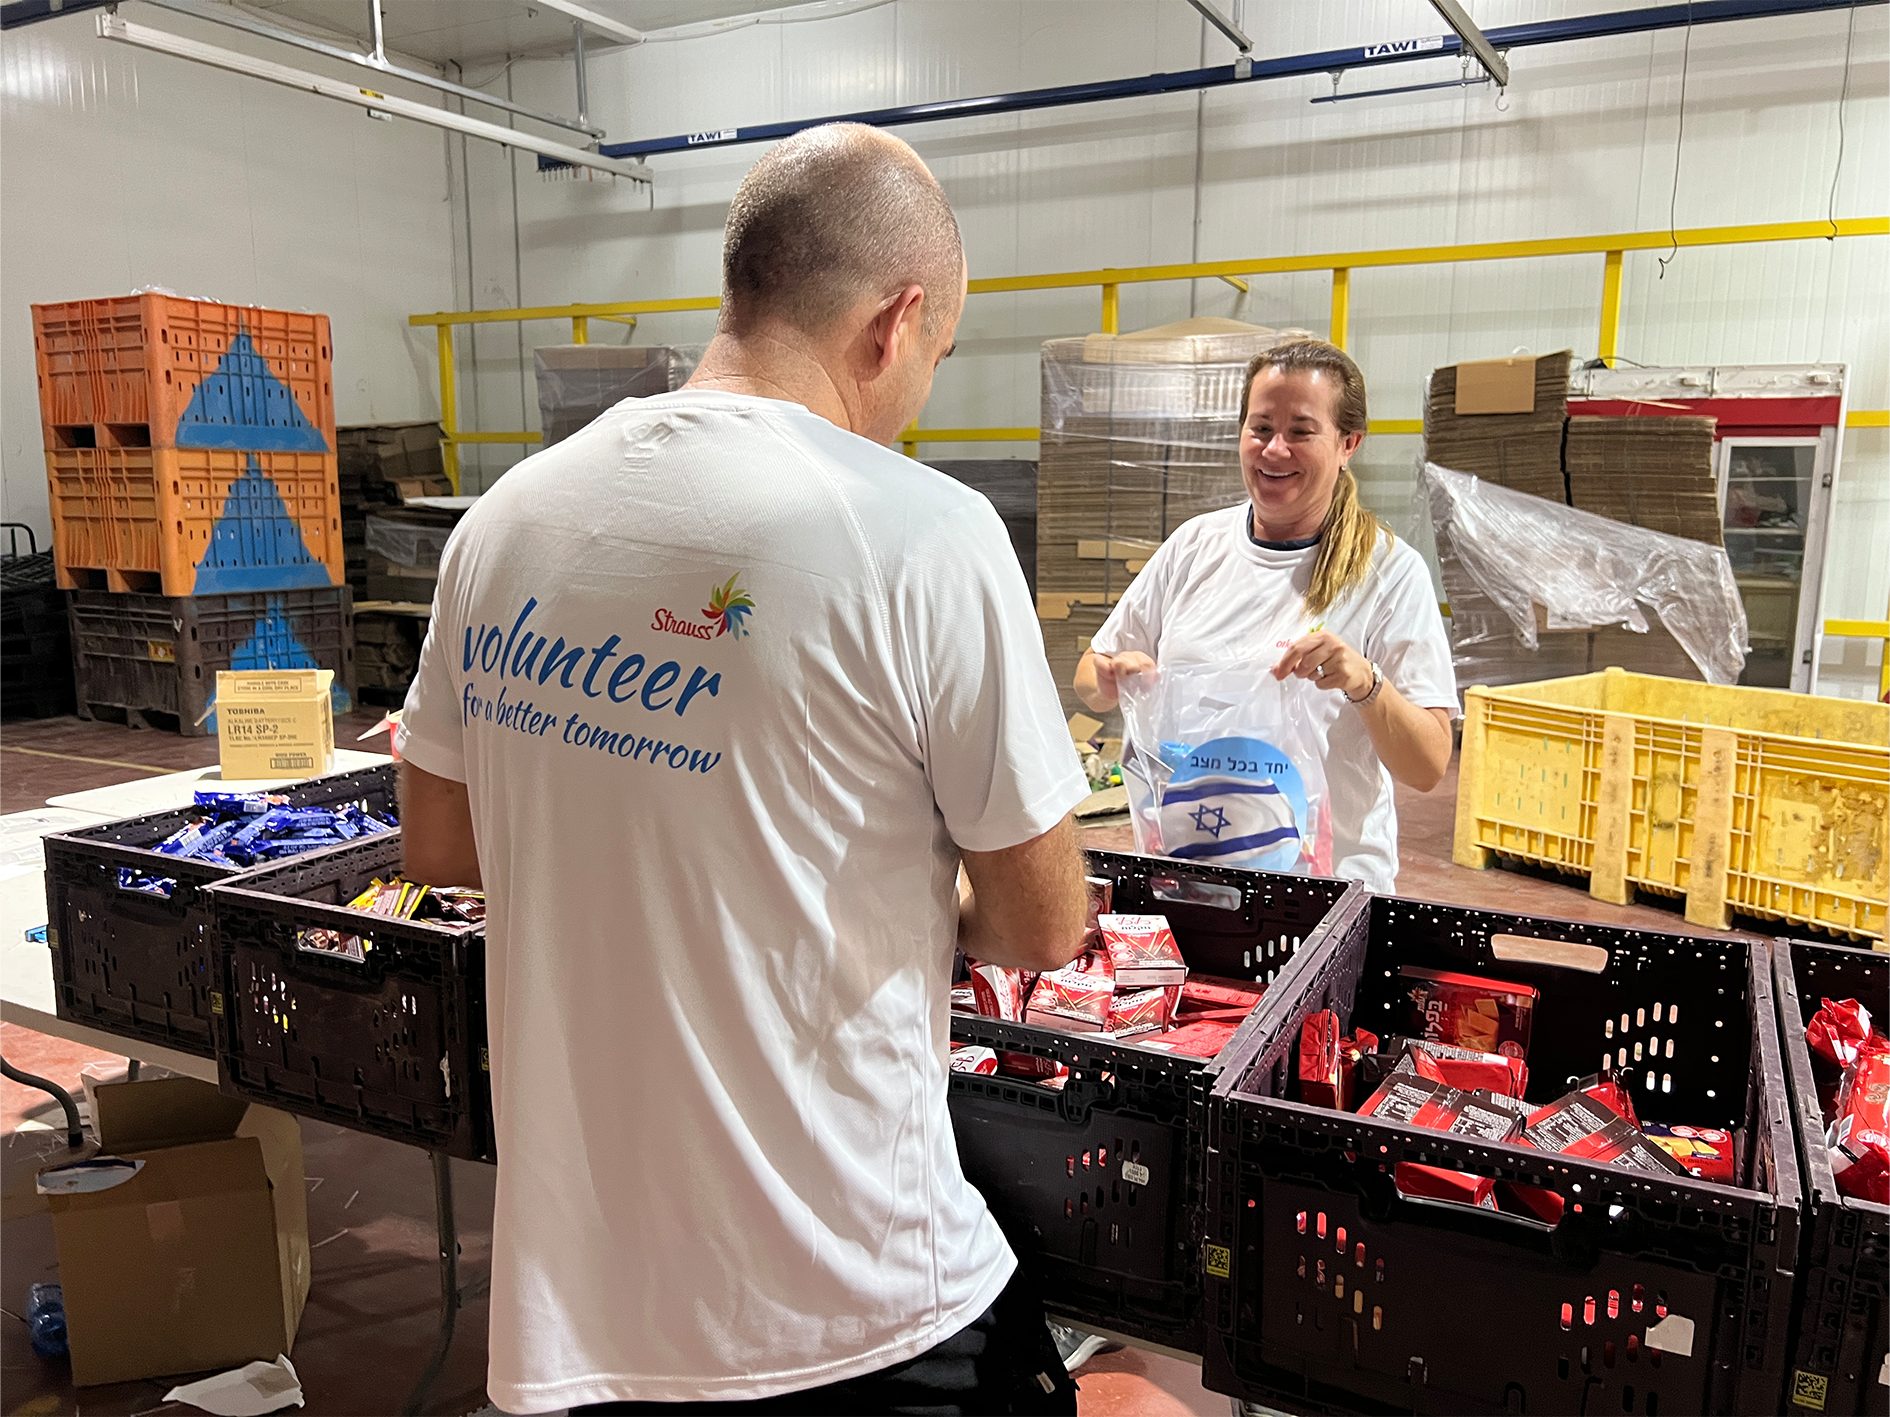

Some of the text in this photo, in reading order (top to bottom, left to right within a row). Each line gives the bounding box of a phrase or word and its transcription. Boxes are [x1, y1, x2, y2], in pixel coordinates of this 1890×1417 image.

[1368, 40, 1417, 55] TAWI
[690, 131, 721, 142] TAWI
[651, 608, 714, 641] Strauss
[462, 596, 722, 717] volunteer
[228, 724, 279, 735] LR14 SP-2
[462, 682, 722, 774] for a better tomorrow
[1190, 756, 1289, 774] יחד בכל מצב
